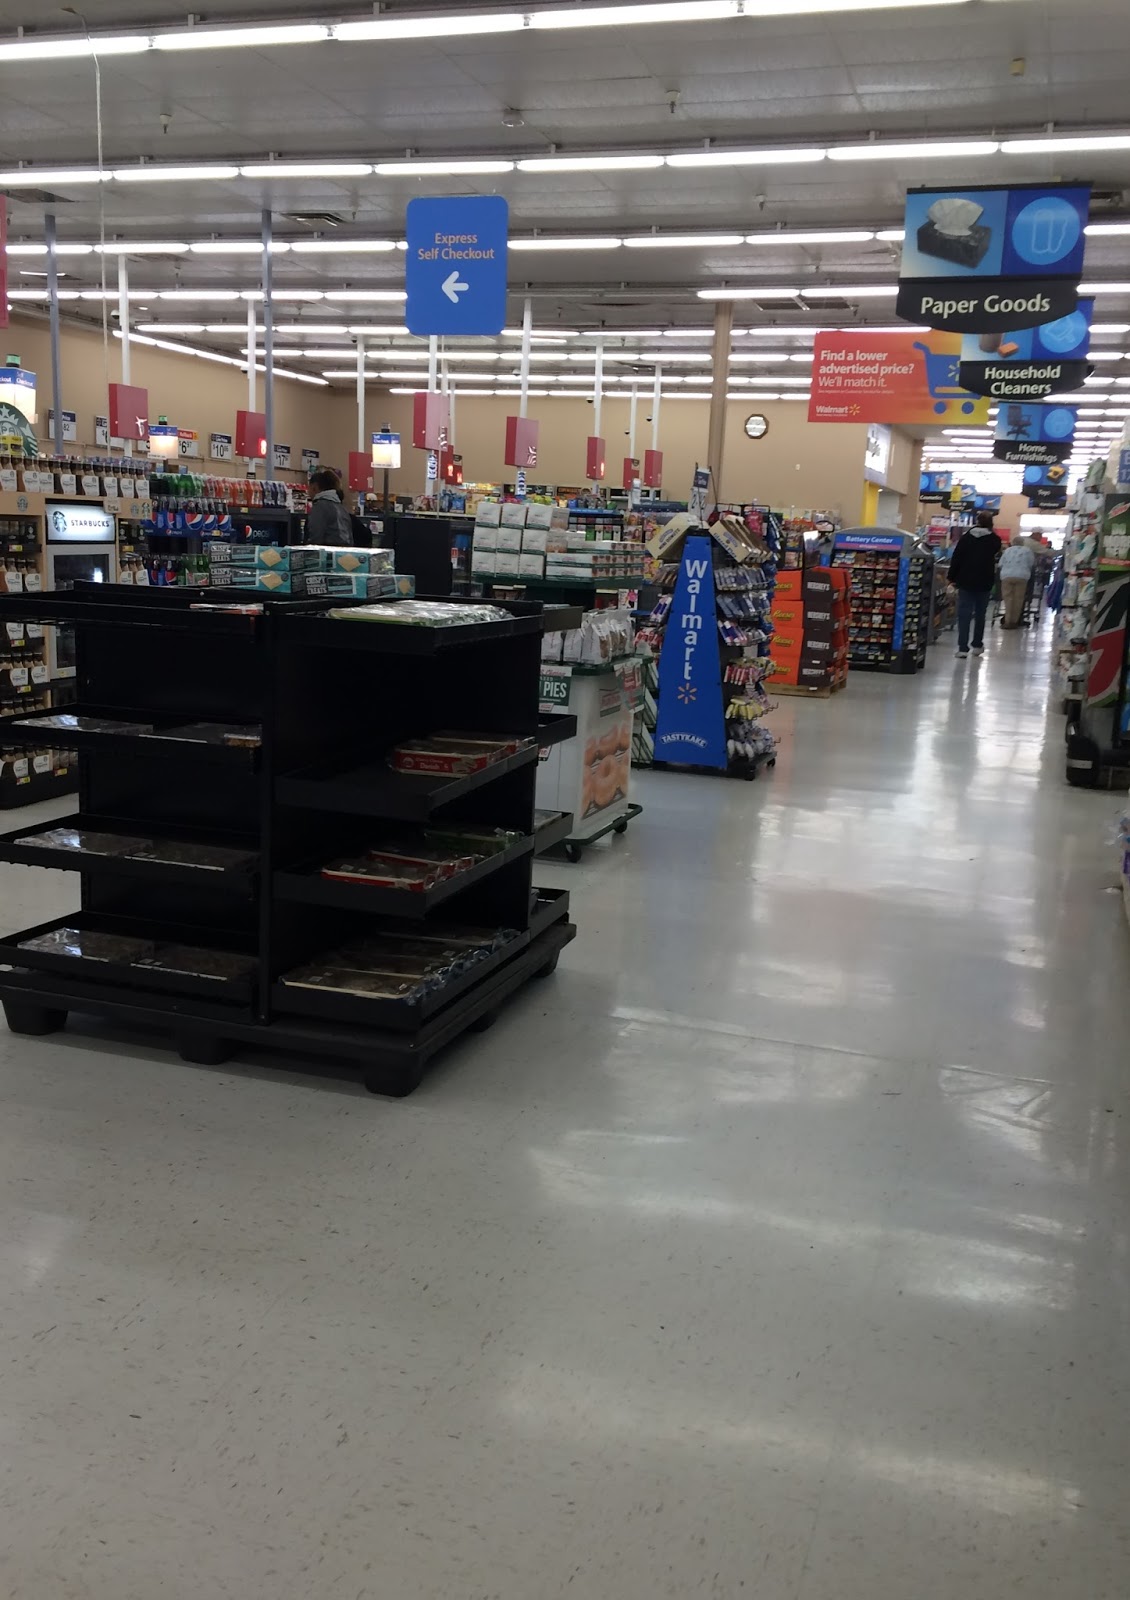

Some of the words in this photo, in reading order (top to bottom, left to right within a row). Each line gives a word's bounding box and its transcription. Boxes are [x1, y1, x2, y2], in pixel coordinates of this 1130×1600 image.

[434, 232, 478, 246] Express
[417, 247, 439, 260] Self
[441, 247, 495, 260] Checkout
[920, 296, 978, 319] Paper
[983, 293, 1050, 313] Goods
[820, 350, 845, 361] Find
[846, 352, 854, 361] a
[856, 350, 888, 361] lower
[819, 363, 879, 374] advertised
[880, 363, 915, 377] price?
[984, 365, 1061, 380] Household
[818, 376, 842, 387] We'll
[844, 376, 876, 387] match
[877, 376, 887, 387] it.
[990, 382, 1052, 395] Cleaners
[815, 405, 848, 414] Walmart
[1018, 442, 1047, 453] Home
[1005, 451, 1058, 464] Furnishings
[70, 519, 110, 528] STARBUCKS
[845, 536, 871, 544] Battery
[871, 536, 893, 544] Center
[681, 559, 708, 680] Walmart
[543, 681, 567, 698] PIES
[661, 733, 706, 747] TASTYKAKE
